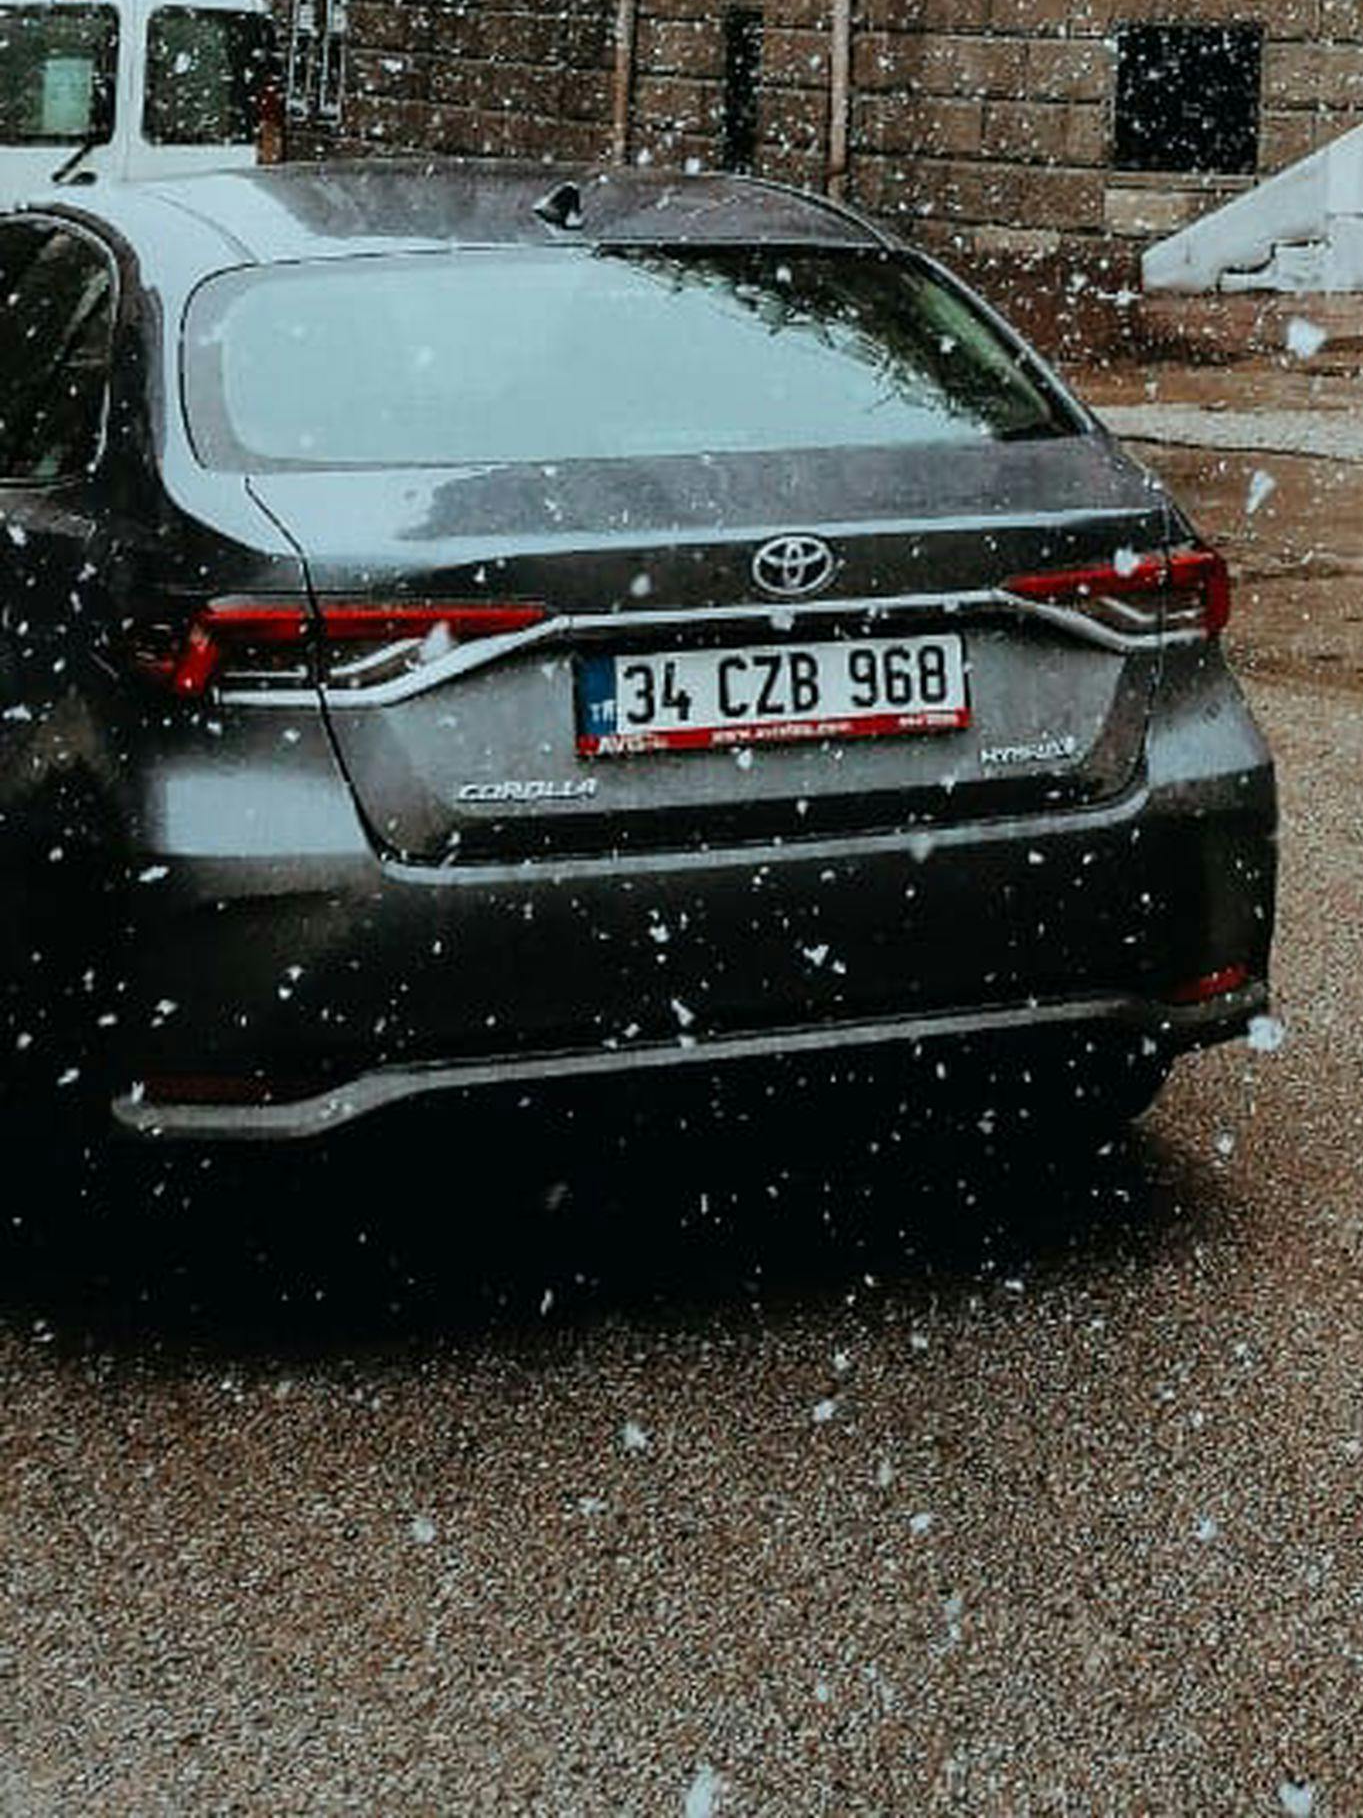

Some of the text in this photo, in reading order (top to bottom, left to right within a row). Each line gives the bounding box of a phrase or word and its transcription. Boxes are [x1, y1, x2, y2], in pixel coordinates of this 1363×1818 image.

[622, 643, 948, 725] 34 CZB 968
[589, 699, 617, 723] TR
[458, 777, 598, 802] COROLLA
